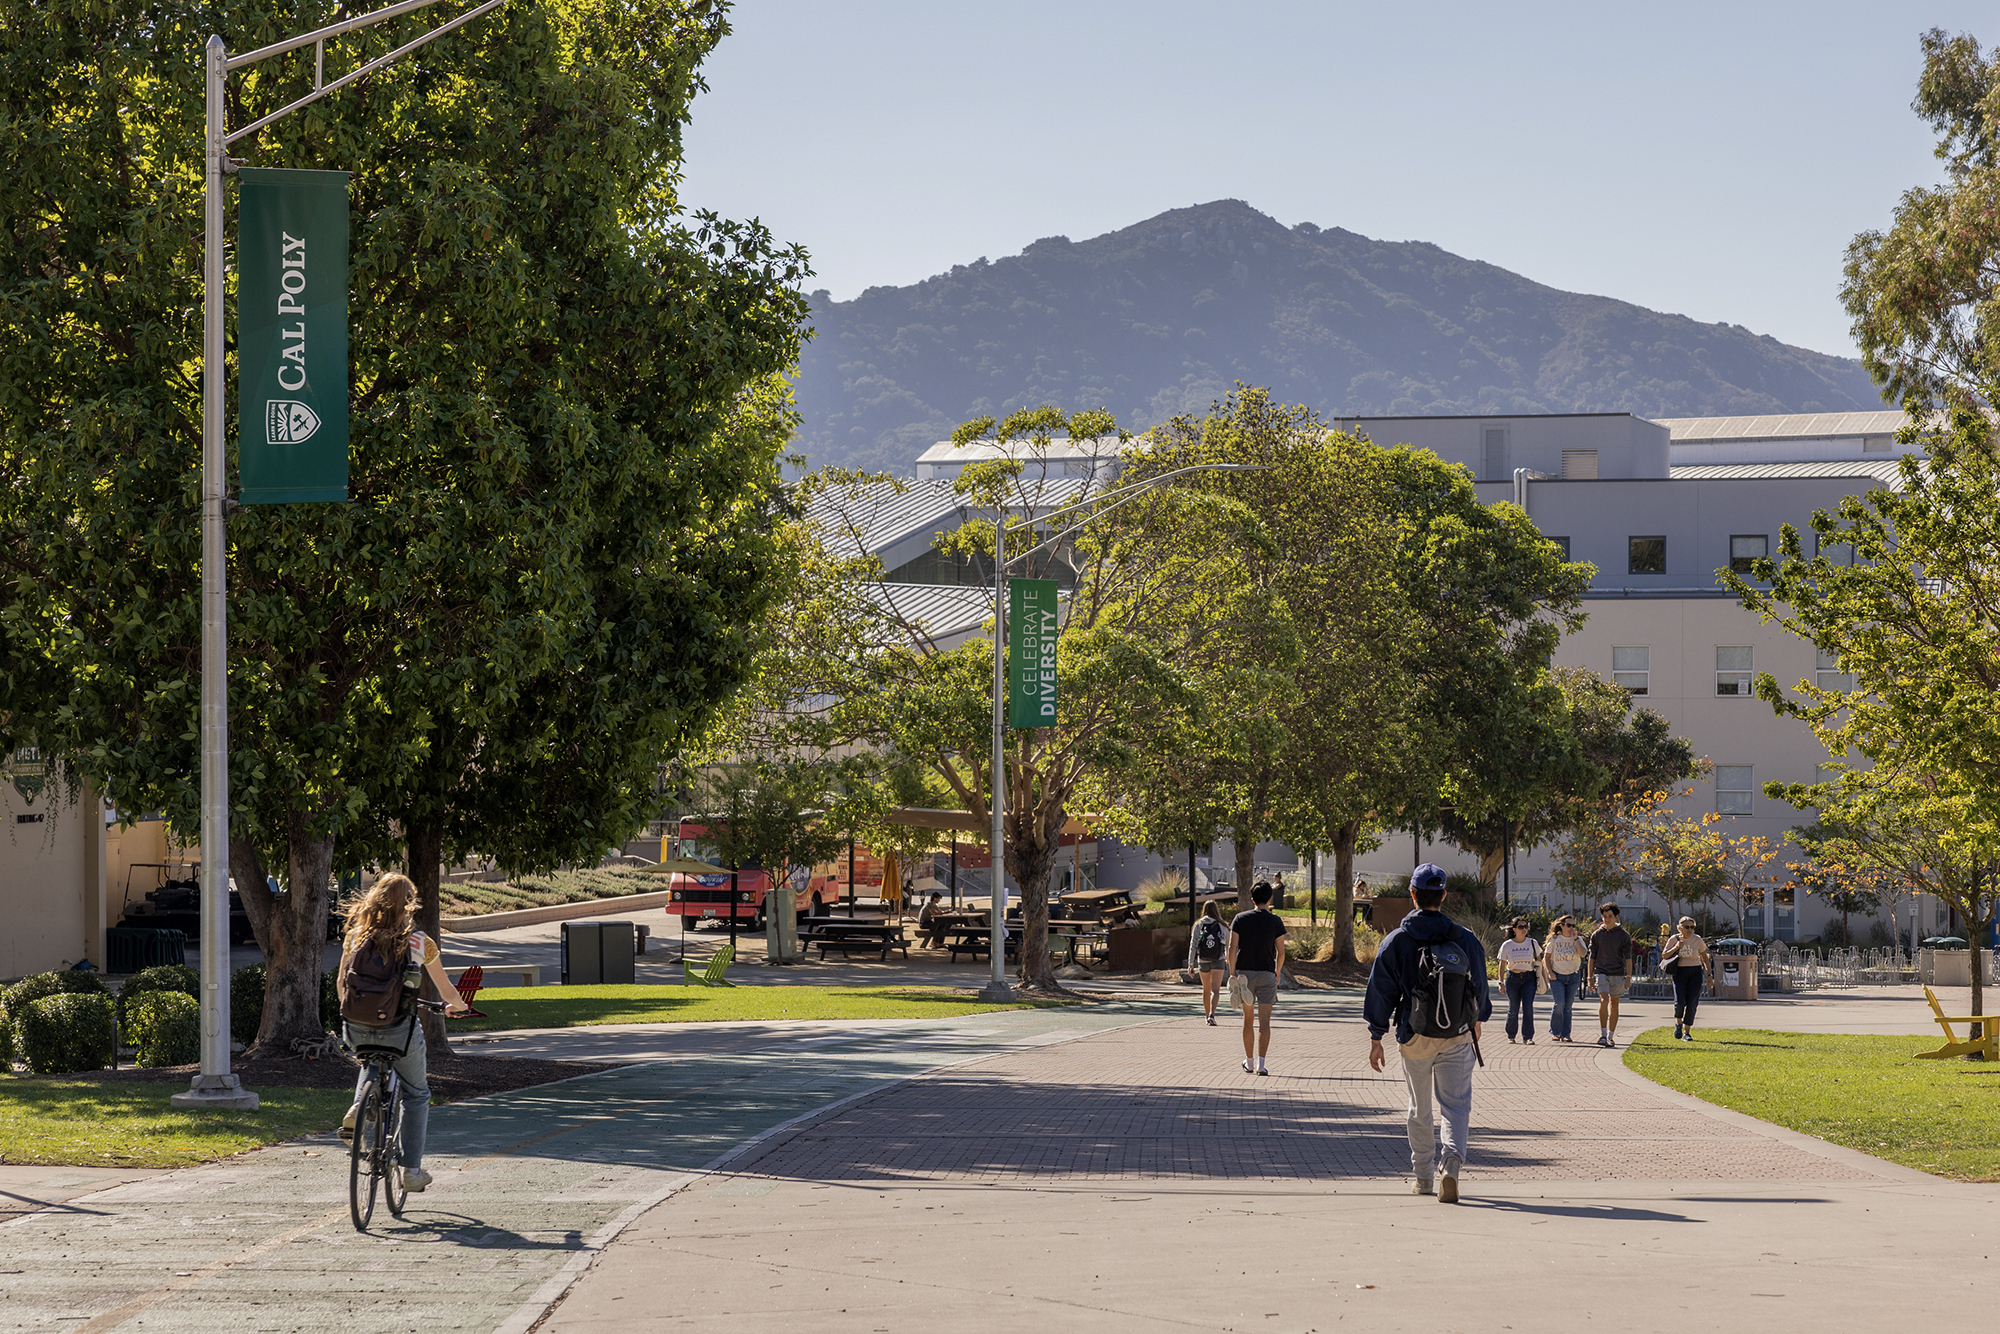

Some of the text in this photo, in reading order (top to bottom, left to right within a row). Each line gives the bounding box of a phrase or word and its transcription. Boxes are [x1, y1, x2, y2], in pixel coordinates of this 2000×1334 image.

[277, 231, 307, 391] CAL POLY
[1022, 590, 1038, 696] CELEBRATE
[1040, 609, 1056, 716] DIVERSITY
